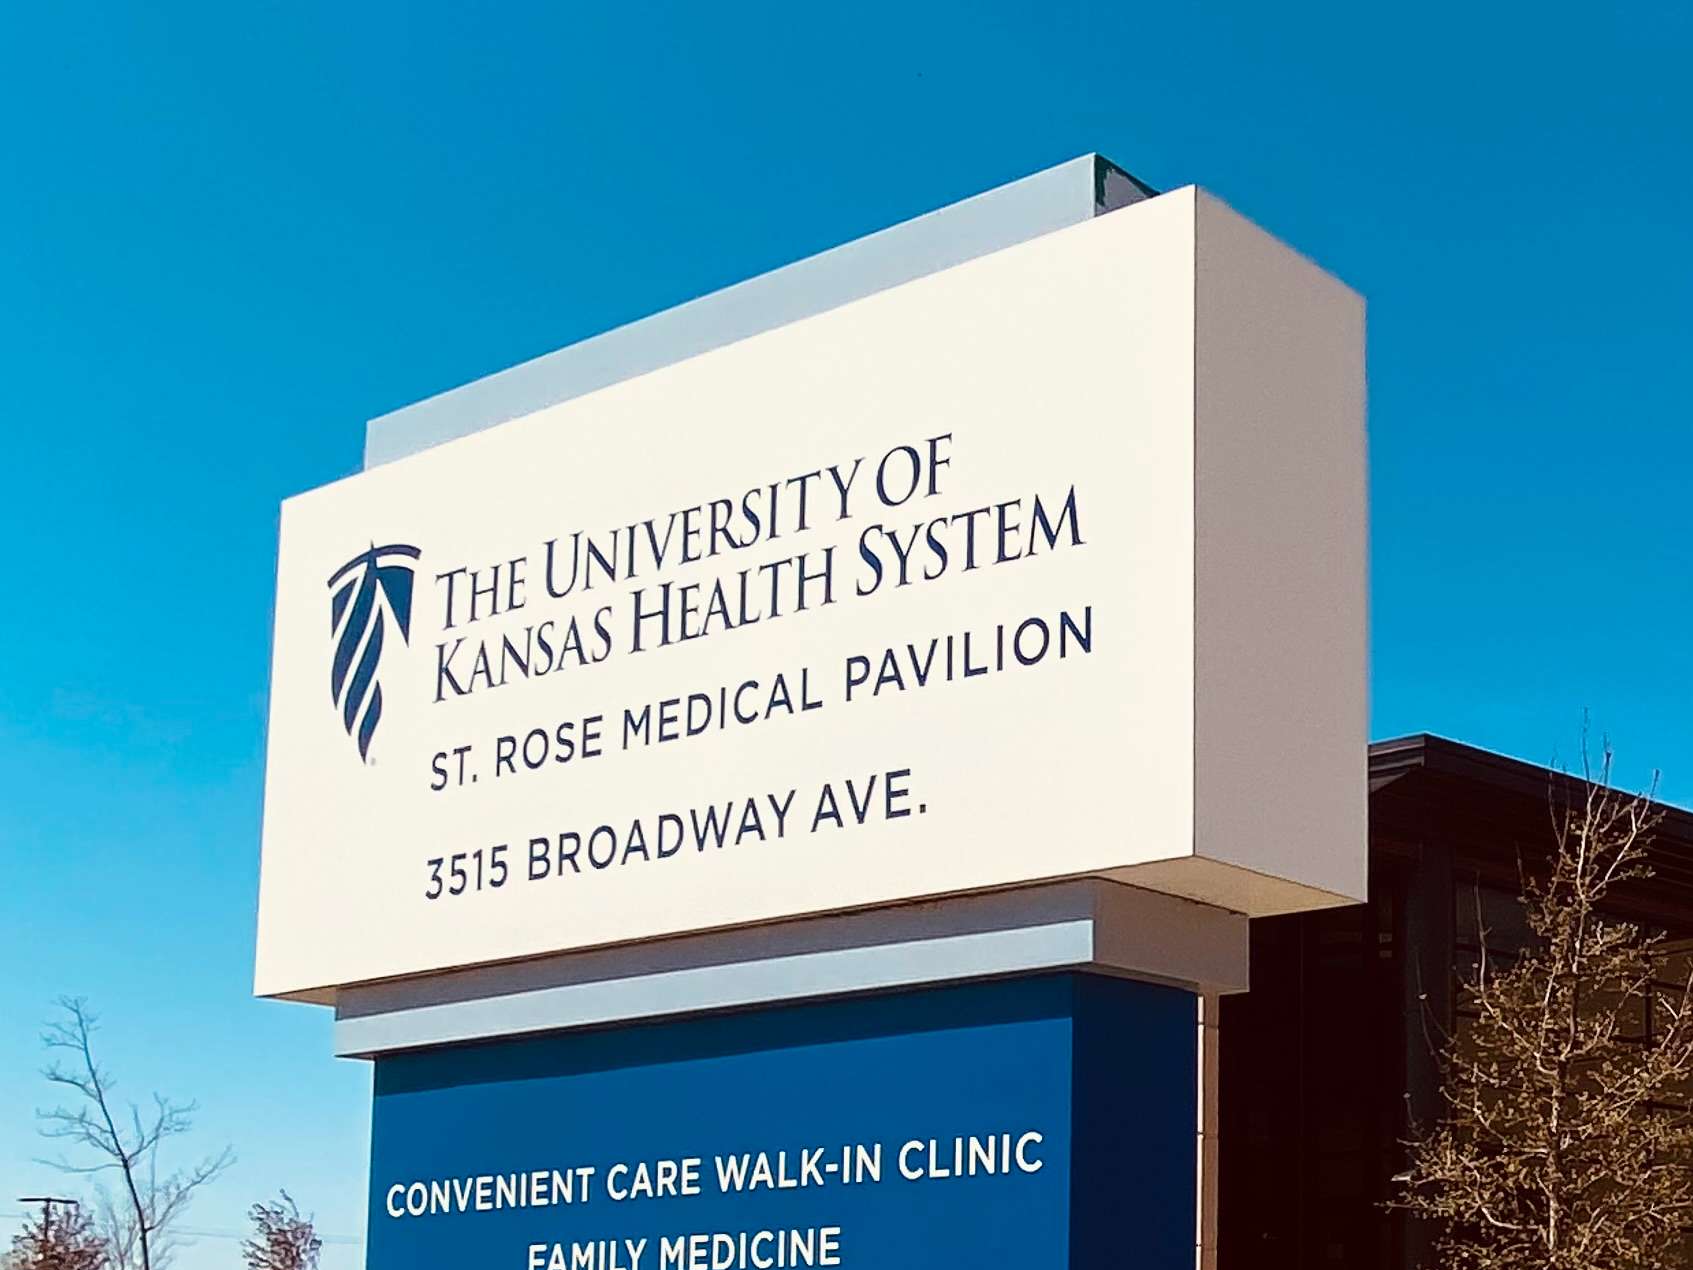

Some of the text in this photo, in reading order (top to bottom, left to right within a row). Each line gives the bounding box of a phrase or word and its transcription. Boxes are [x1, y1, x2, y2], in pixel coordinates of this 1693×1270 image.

[434, 484, 1085, 703] KANSAS HEALTH SYSTEM
[435, 432, 953, 631] THE UNIVERSITY OF
[430, 605, 1092, 792] ST. ROSE MEDICAL PAVILION
[425, 767, 927, 900] 3515 BROADWAY AVE.
[386, 1131, 1043, 1218] CONVENIENT CARE WALK-IN CLINIC
